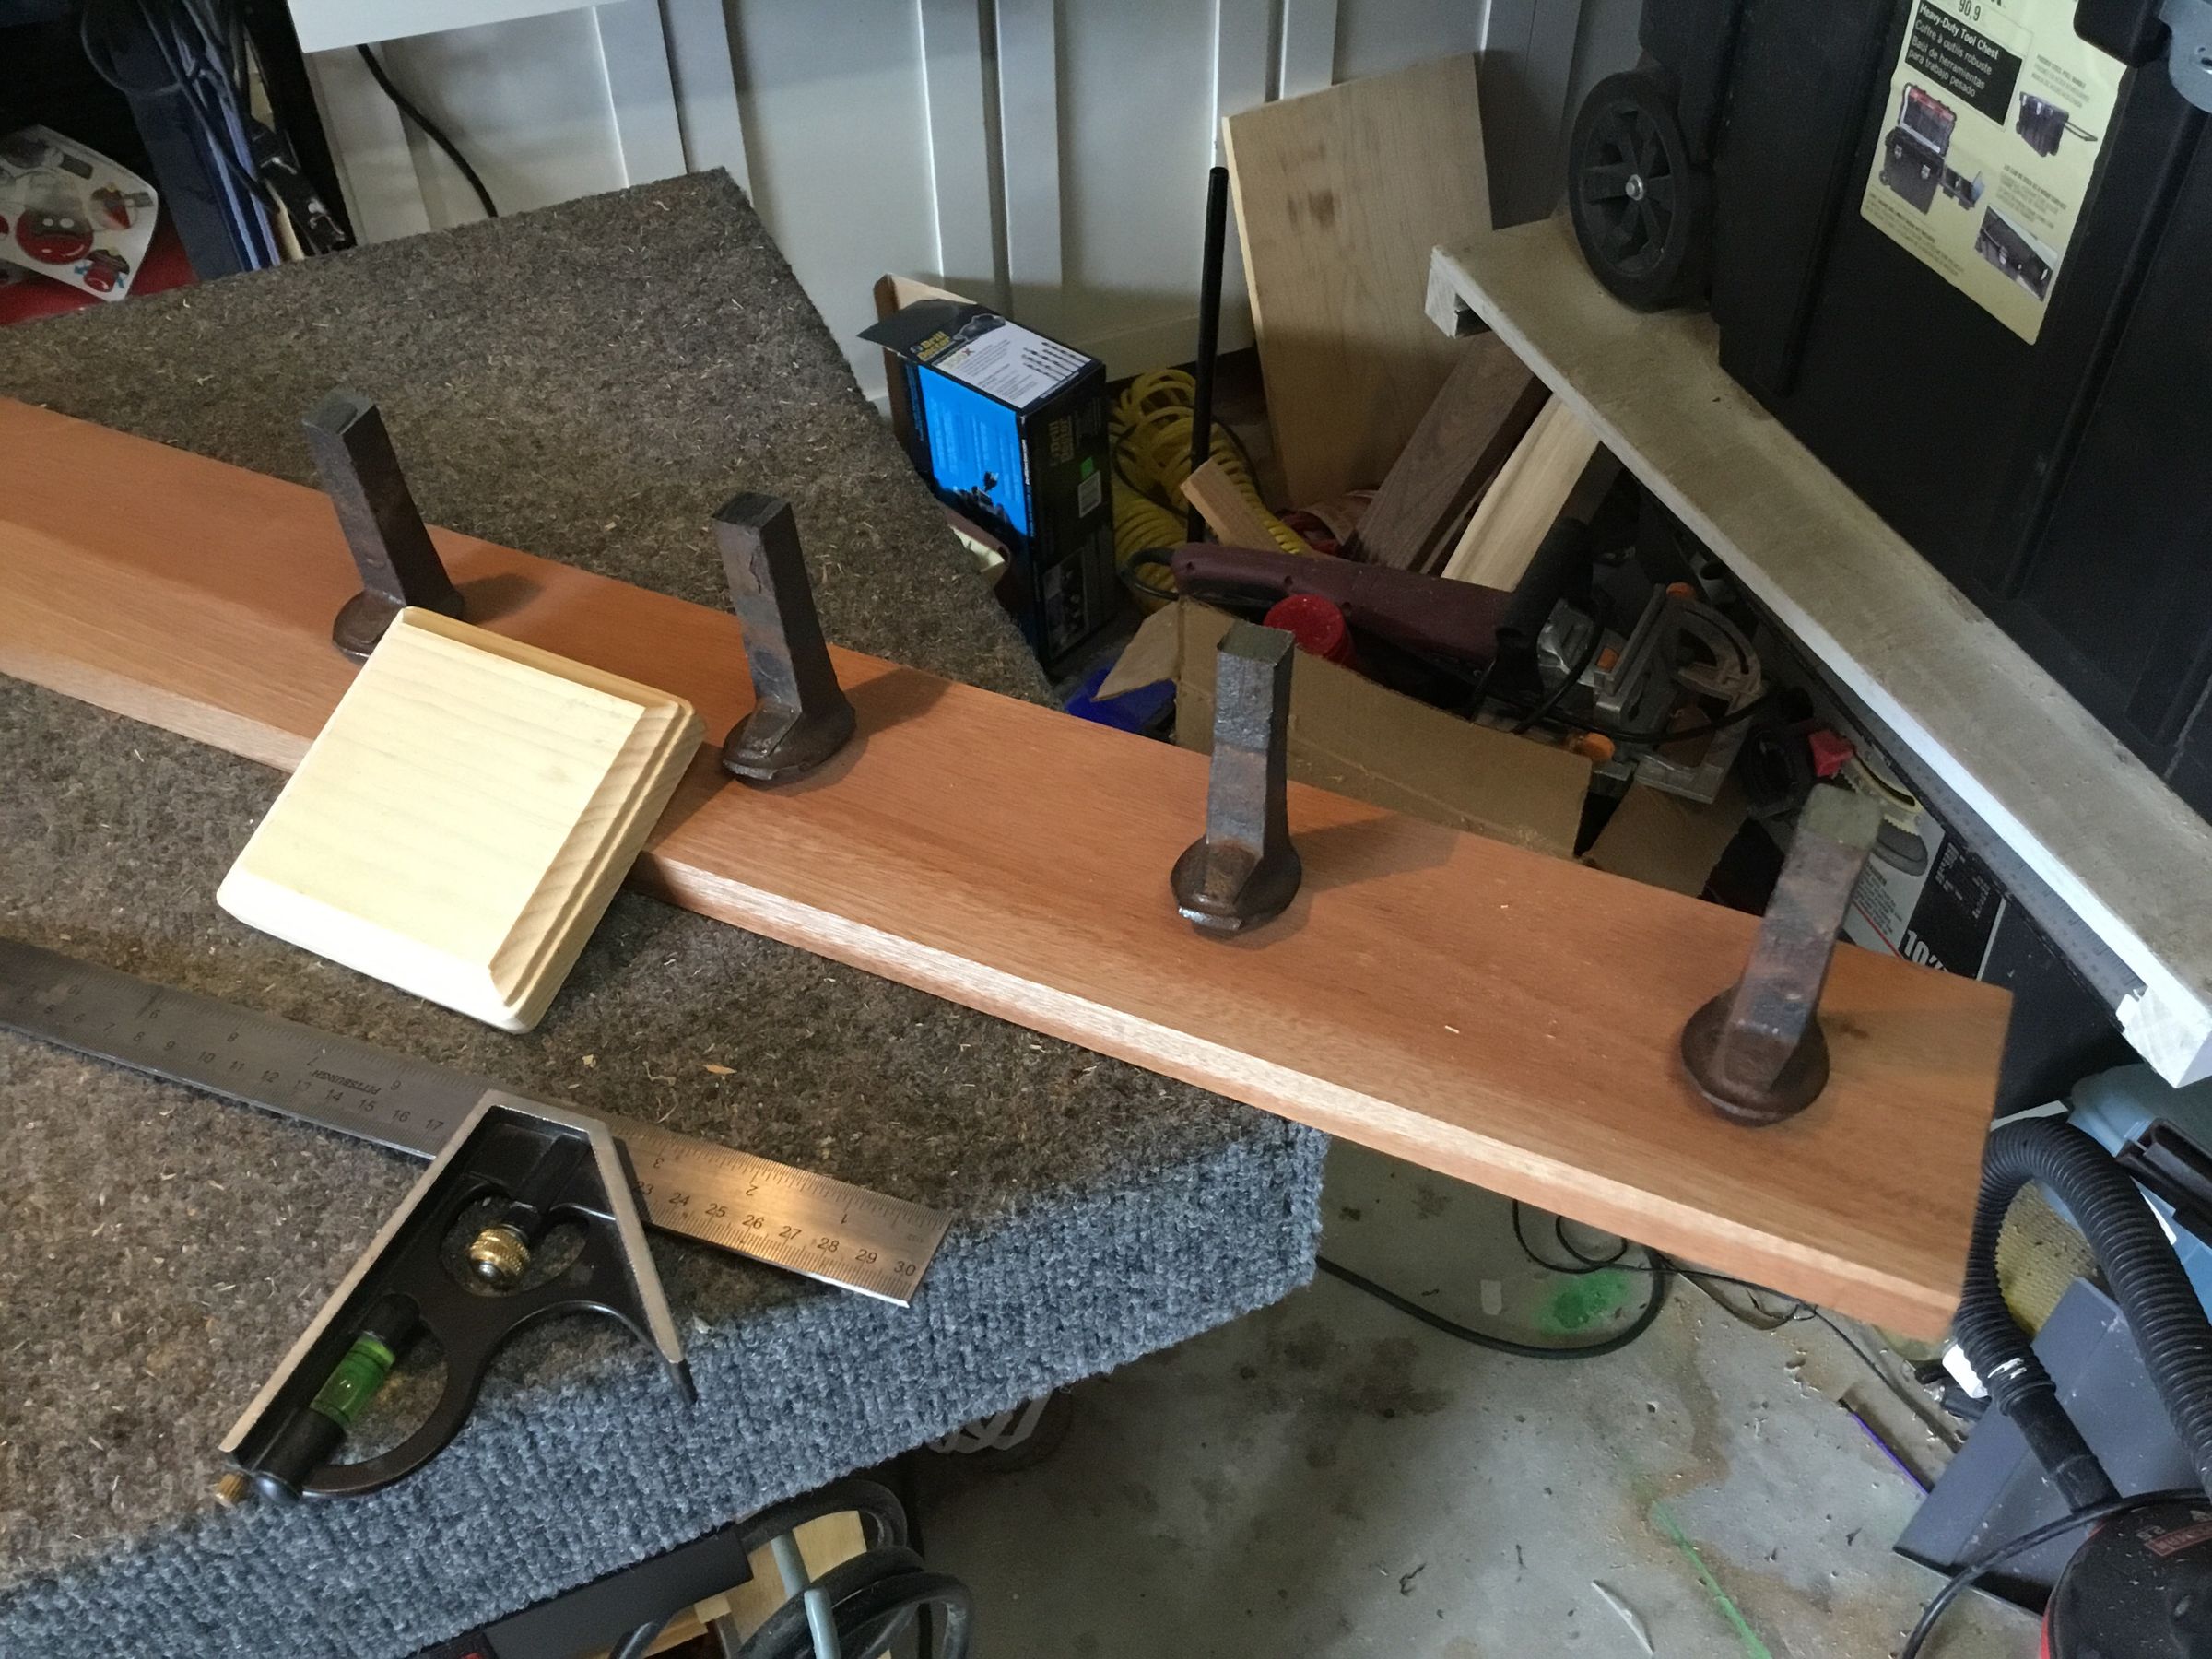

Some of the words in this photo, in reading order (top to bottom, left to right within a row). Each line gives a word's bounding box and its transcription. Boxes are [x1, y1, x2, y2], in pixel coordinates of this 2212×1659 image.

[1920, 4, 1960, 37] Heavy-Duty
[1960, 28, 1977, 46] Tool
[1977, 39, 1999, 60] Chest
[1959, 0, 1982, 21] 90.9
[1915, 19, 1936, 40] Coffre
[1937, 33, 1943, 44] à
[1943, 40, 1964, 58] outils
[1964, 53, 1993, 76] robuste
[1928, 49, 1938, 60] de
[1938, 53, 1986, 90] herramientas
[1907, 49, 1924, 65] para
[1925, 58, 1950, 81] trabajo
[1949, 76, 1976, 98] pesado
[103, 1022, 115, 1032] 7
[164, 1041, 175, 1051] 9
[198, 1051, 216, 1065] 10
[229, 1060, 245, 1072] 11
[262, 1070, 279, 1083] 12
[293, 1079, 312, 1091] 13
[325, 1089, 344, 1102] 14
[359, 1099, 375, 1112] 15
[392, 1109, 410, 1123] 16
[425, 1118, 444, 1132] 17
[633, 1181, 653, 1195] 23
[668, 1192, 691, 1207] 24
[704, 1203, 727, 1218] 25
[741, 1214, 765, 1230] 26
[778, 1225, 802, 1241] 27
[816, 1236, 840, 1253] 28
[855, 1248, 878, 1265] 29
[893, 1260, 916, 1277] 30
[653, 1157, 664, 1169] 3
[745, 1184, 759, 1196] 2
